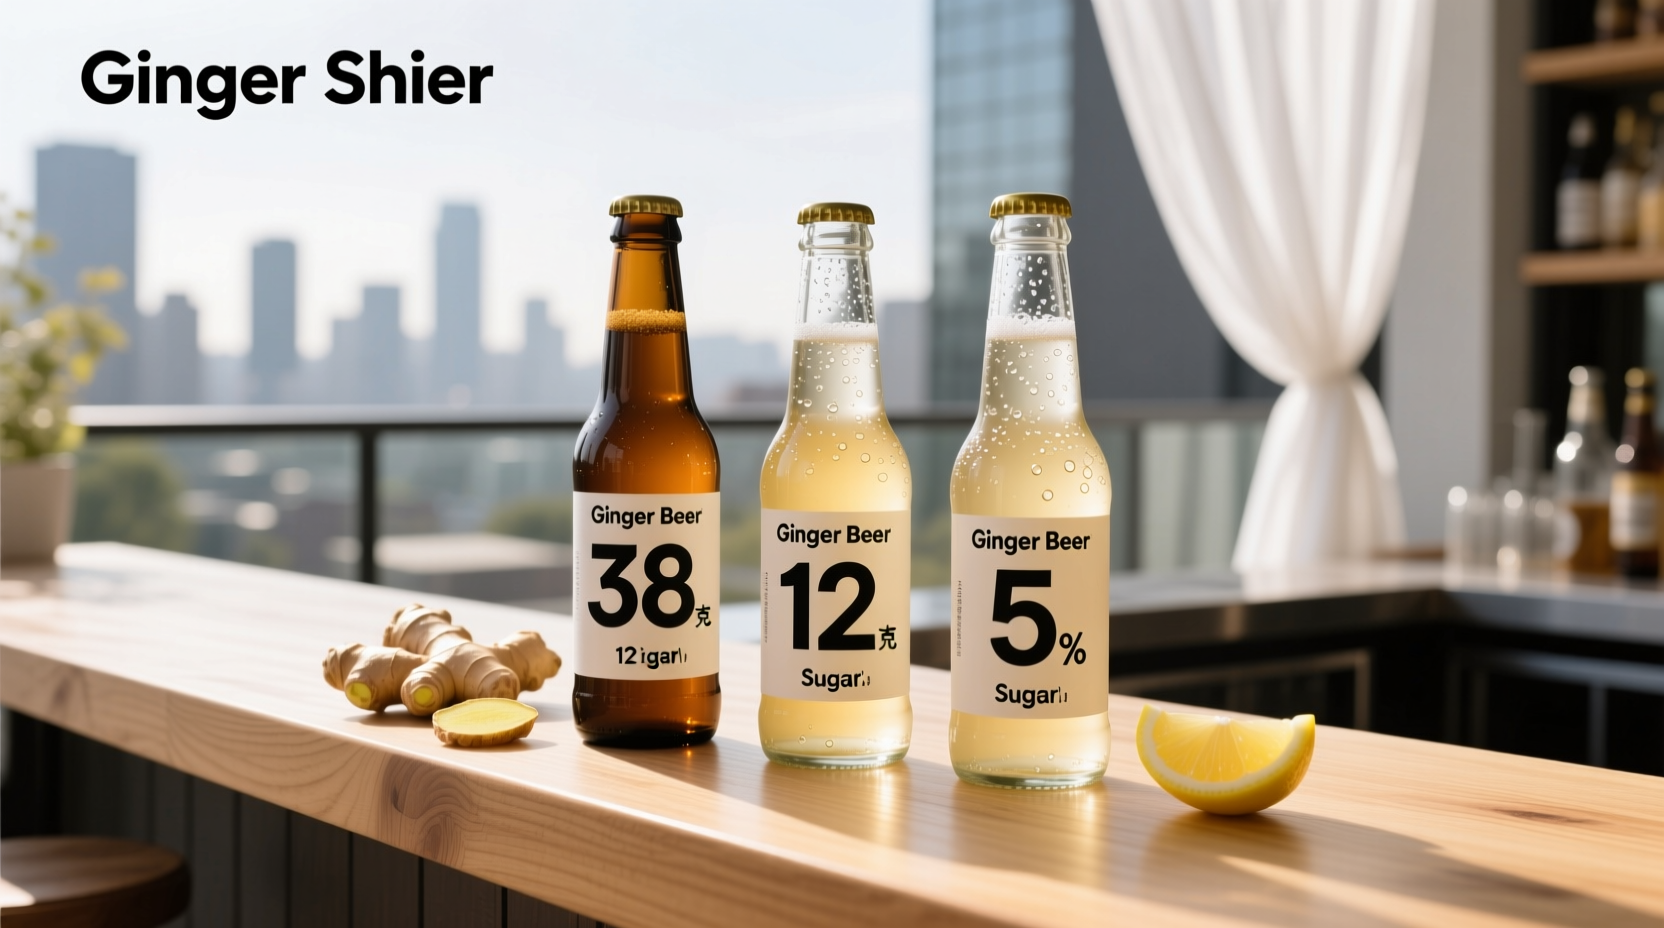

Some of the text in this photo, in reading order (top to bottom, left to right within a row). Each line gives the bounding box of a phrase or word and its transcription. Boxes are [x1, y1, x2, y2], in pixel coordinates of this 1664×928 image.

[591, 504, 703, 530] Ginger Beer
[776, 522, 892, 549] Ginger Beer
[971, 528, 1091, 556] Ginger Beer
